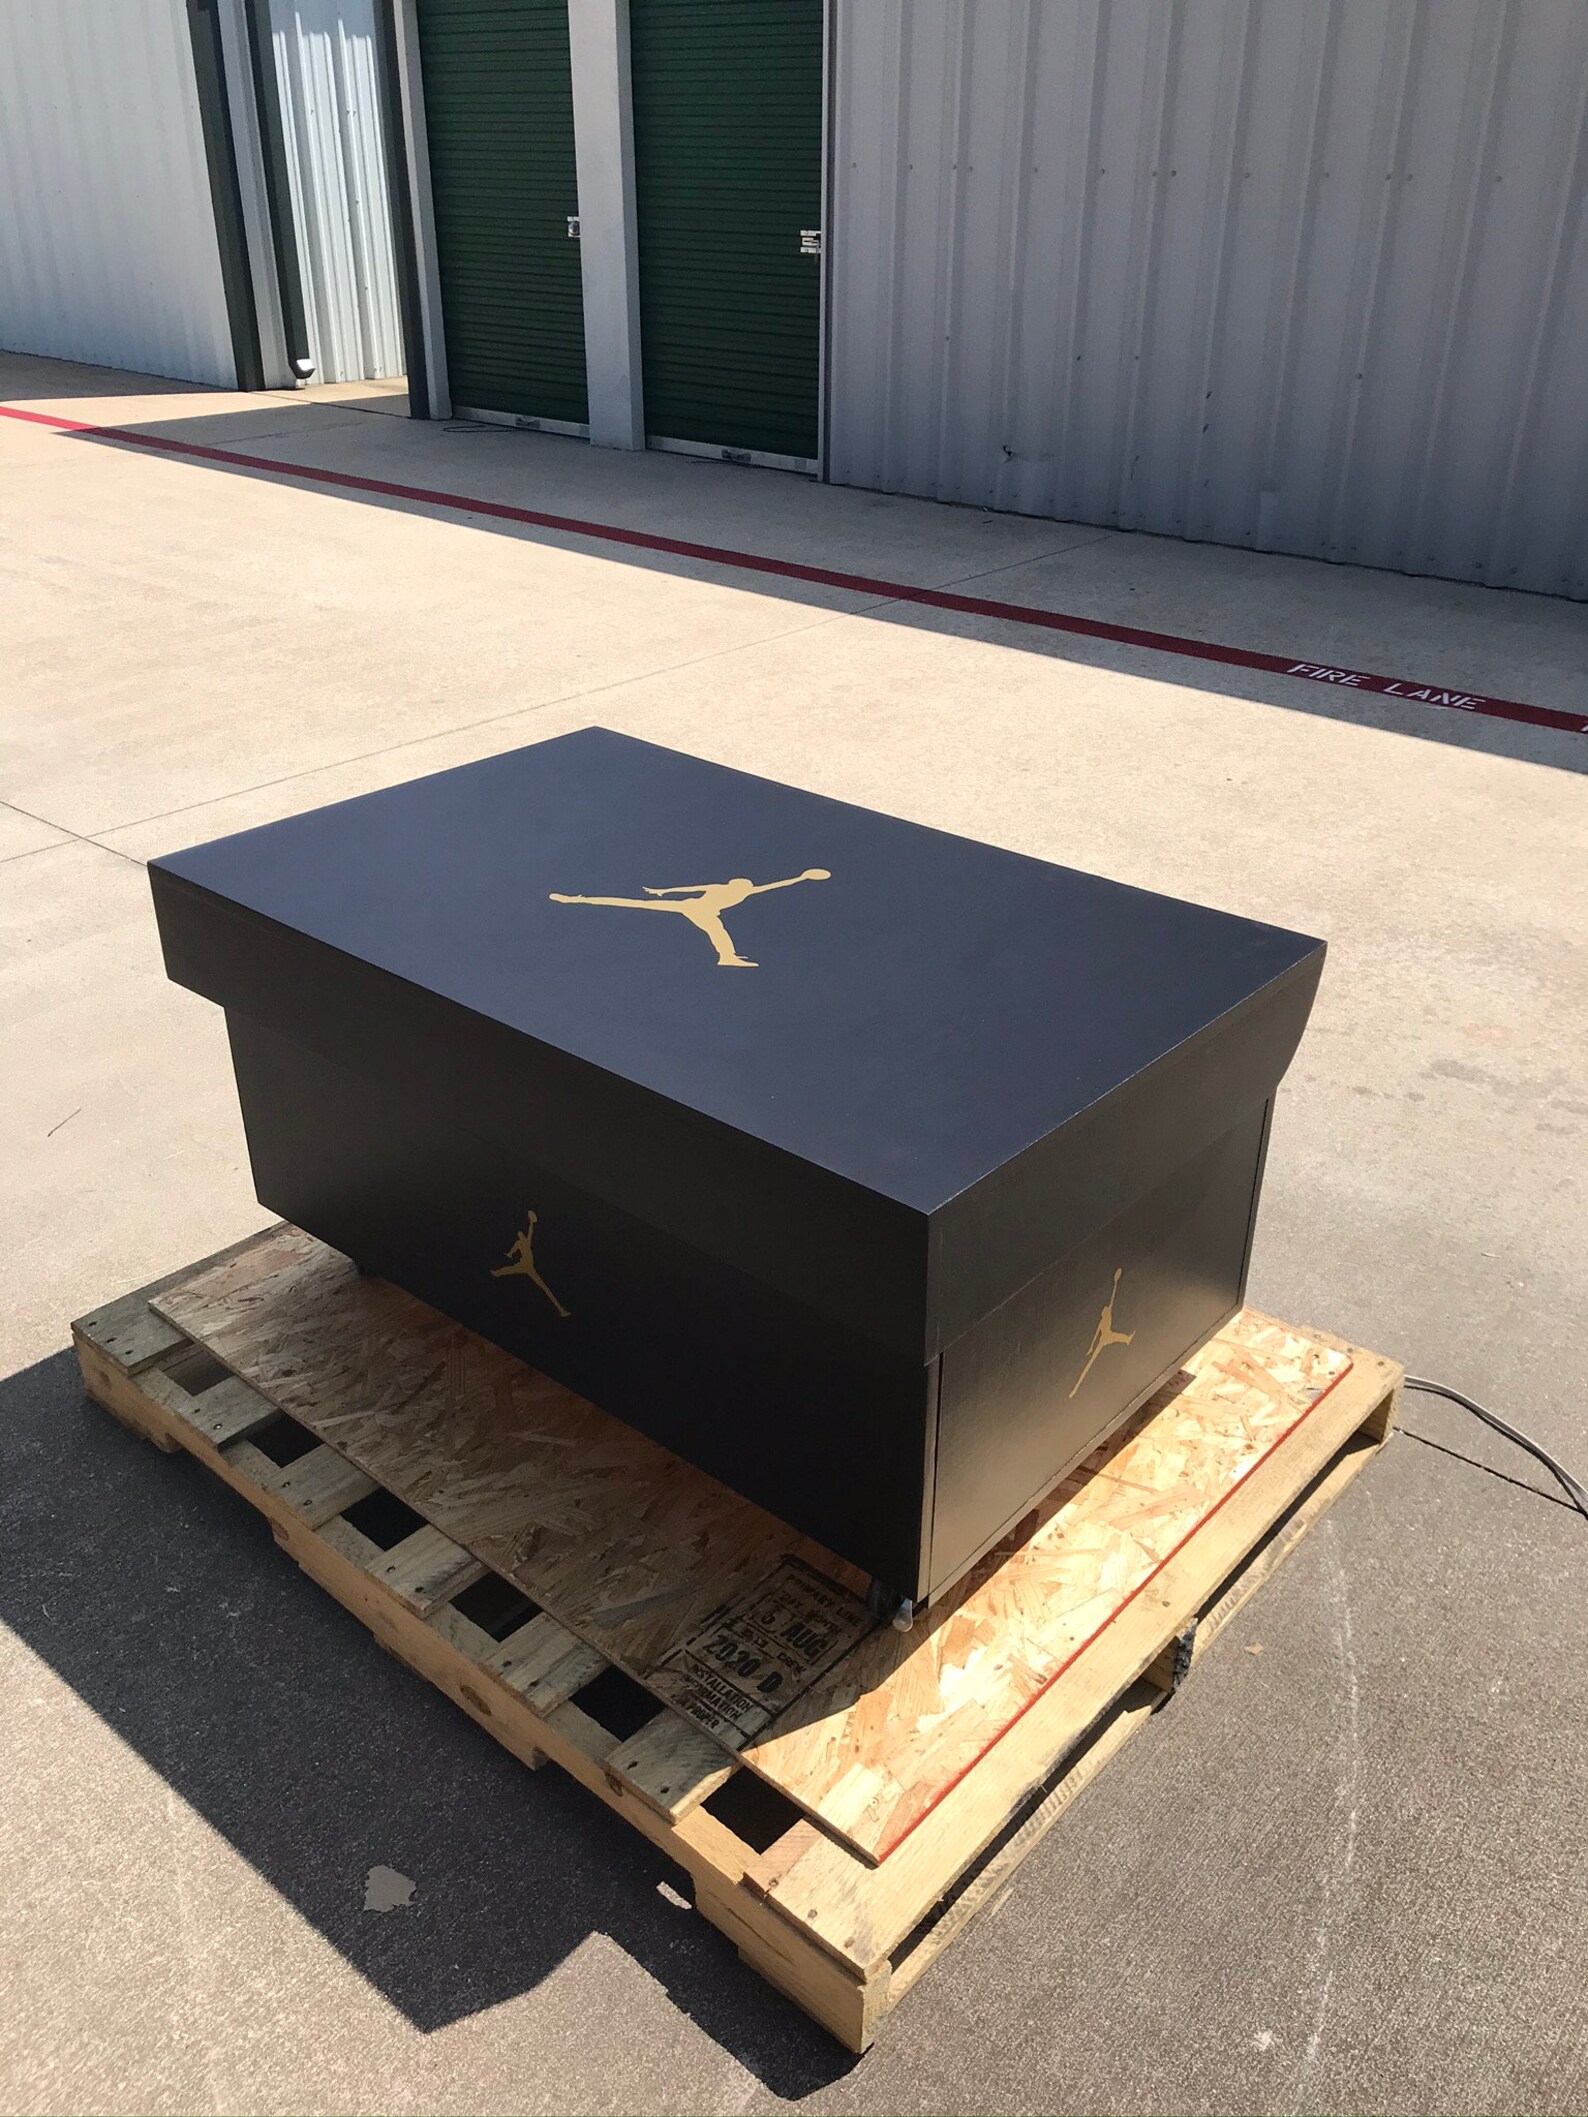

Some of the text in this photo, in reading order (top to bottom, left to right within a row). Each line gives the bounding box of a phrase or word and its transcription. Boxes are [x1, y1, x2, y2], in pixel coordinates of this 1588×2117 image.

[1287, 663, 1487, 711] FIRE LANE
[836, 1606, 864, 1628] LINE
[702, 1633, 761, 1677] 2020
[780, 1622, 828, 1658] AUG
[777, 1652, 807, 1673] CREW
